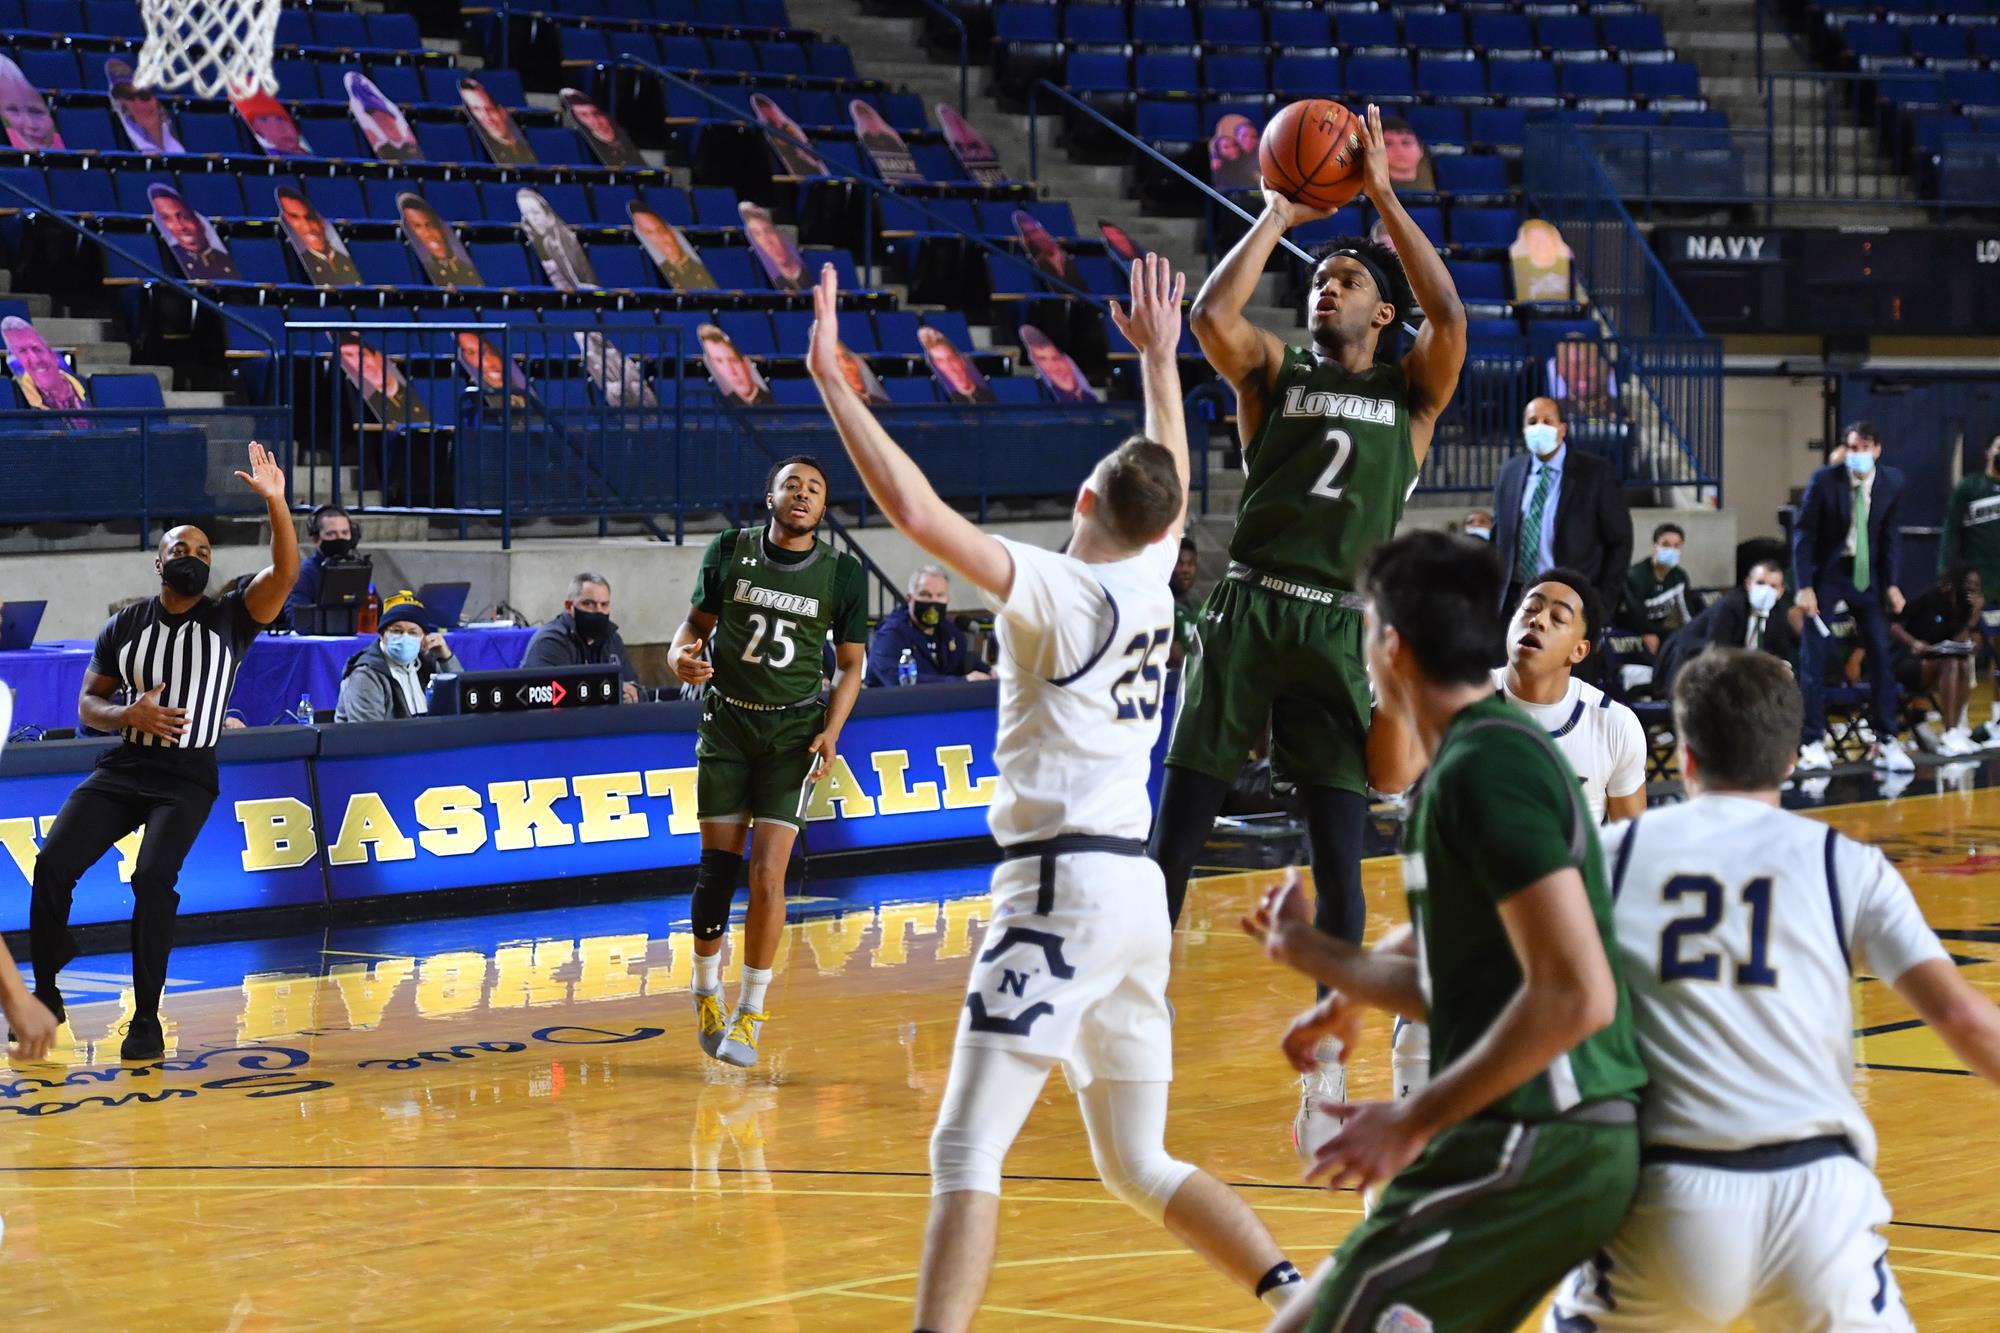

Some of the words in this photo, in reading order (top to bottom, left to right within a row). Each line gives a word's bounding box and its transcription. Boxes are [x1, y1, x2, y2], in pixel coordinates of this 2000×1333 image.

[1686, 235, 1765, 260] NAVY
[1976, 239, 2000, 263] LO
[1309, 428, 1354, 500] 2
[1260, 575, 1334, 604] HOUNDS
[741, 613, 798, 669] 25
[528, 685, 554, 703] POSS
[1112, 623, 1172, 722] 25
[234, 744, 1000, 873] BASKETALL
[1658, 871, 1778, 988] 21
[996, 968, 1031, 998] N
